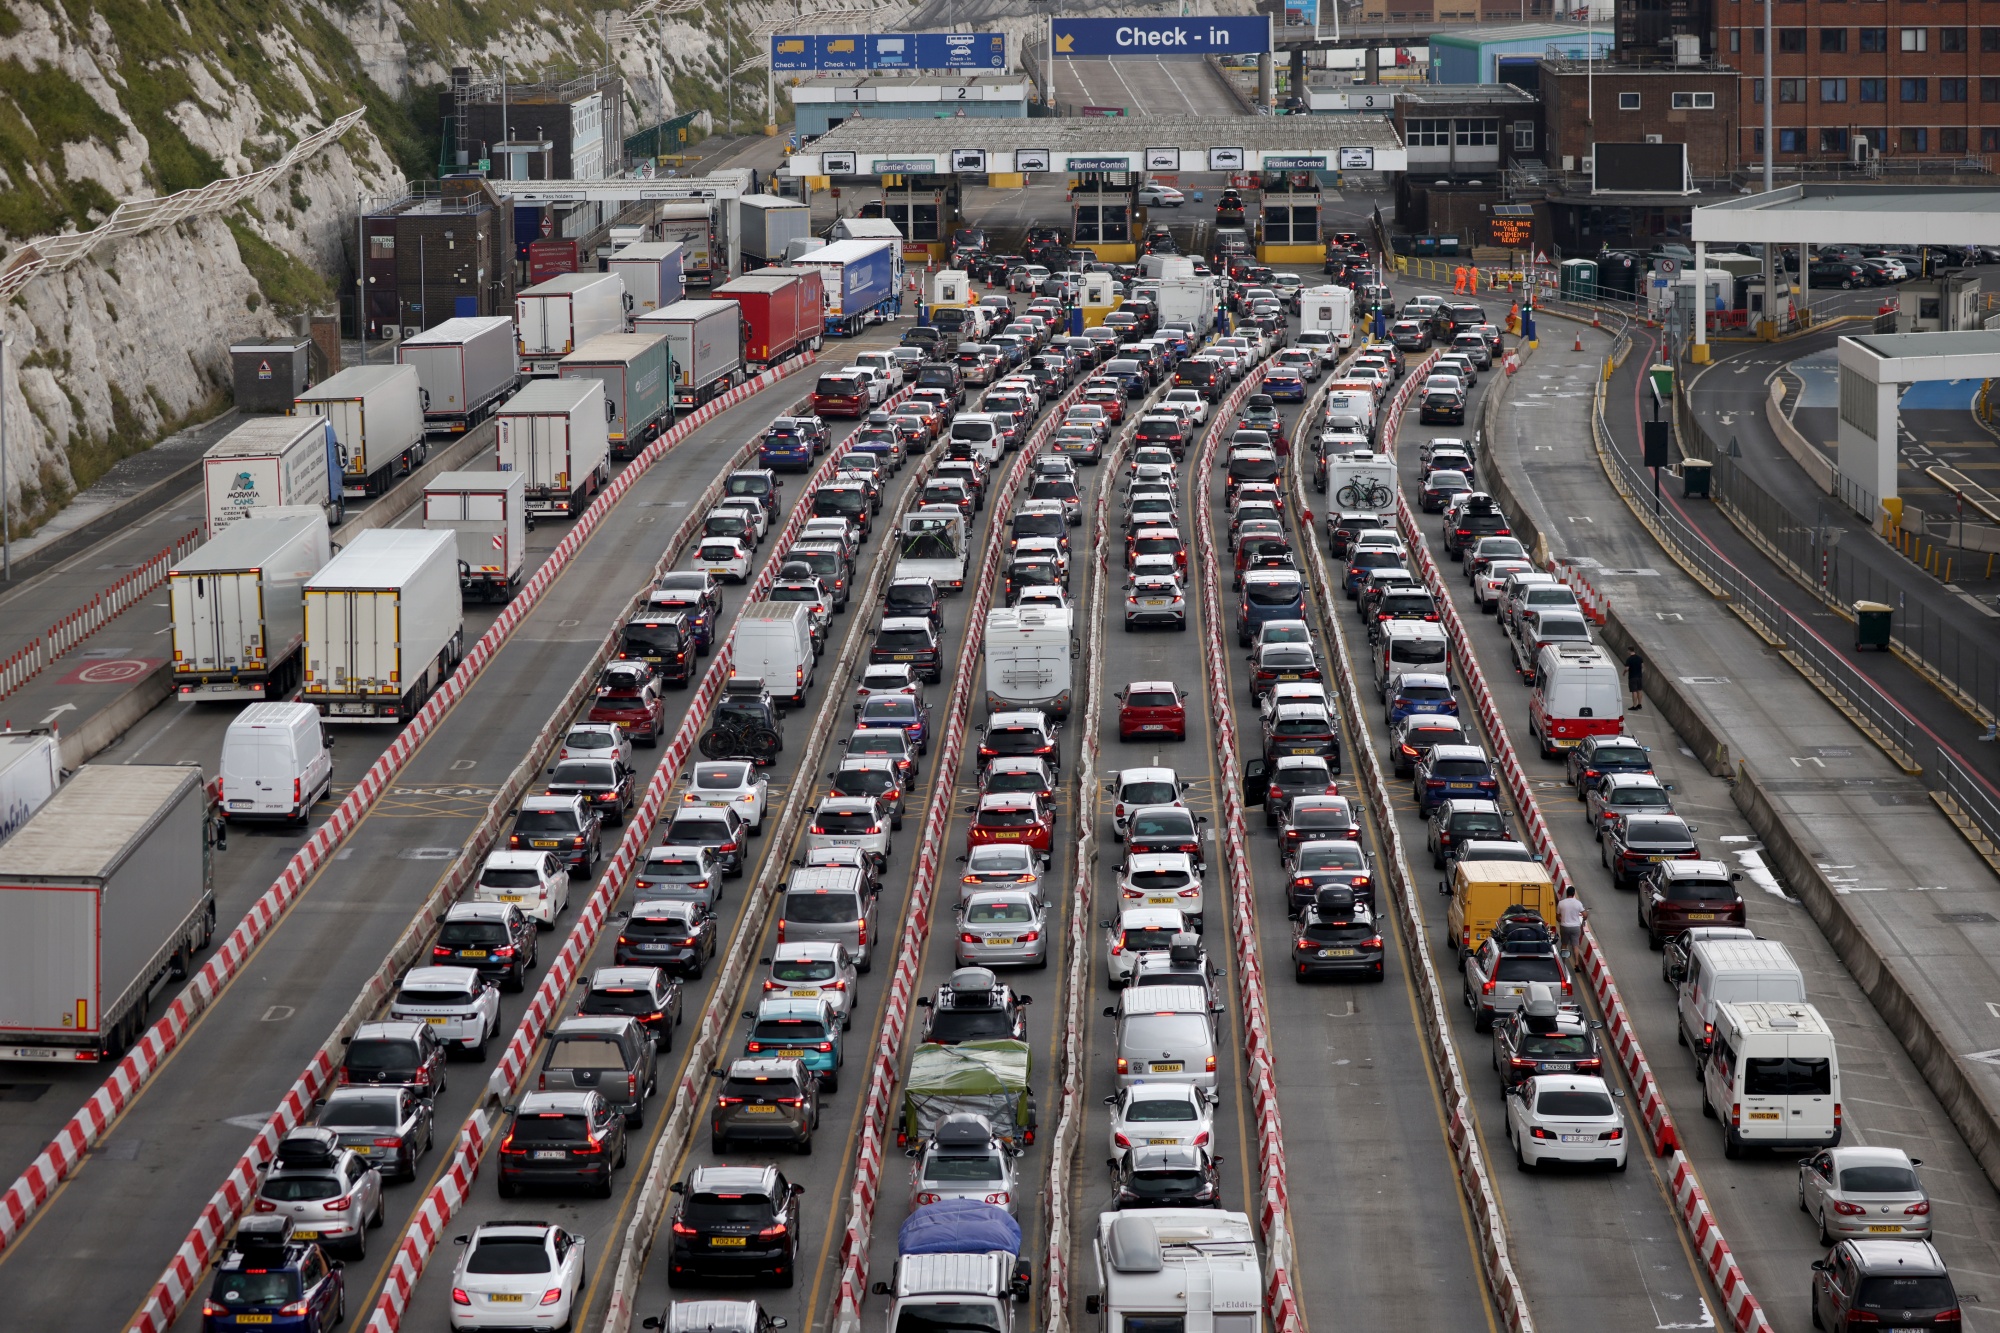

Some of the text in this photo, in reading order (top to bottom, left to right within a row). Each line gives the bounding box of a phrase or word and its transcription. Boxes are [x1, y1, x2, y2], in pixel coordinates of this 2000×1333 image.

[1116, 26, 1187, 46] Check
[1209, 26, 1229, 45] in
[853, 89, 860, 100] 1
[958, 88, 966, 99] 2
[1366, 95, 1374, 108] 3
[877, 163, 933, 171] Frontier Control
[1070, 161, 1127, 169] Frontier Control
[1297, 159, 1324, 167] Control
[227, 491, 260, 499] MORAVIA
[234, 498, 255, 506] CANS
[261, 1005, 296, 1021] D
